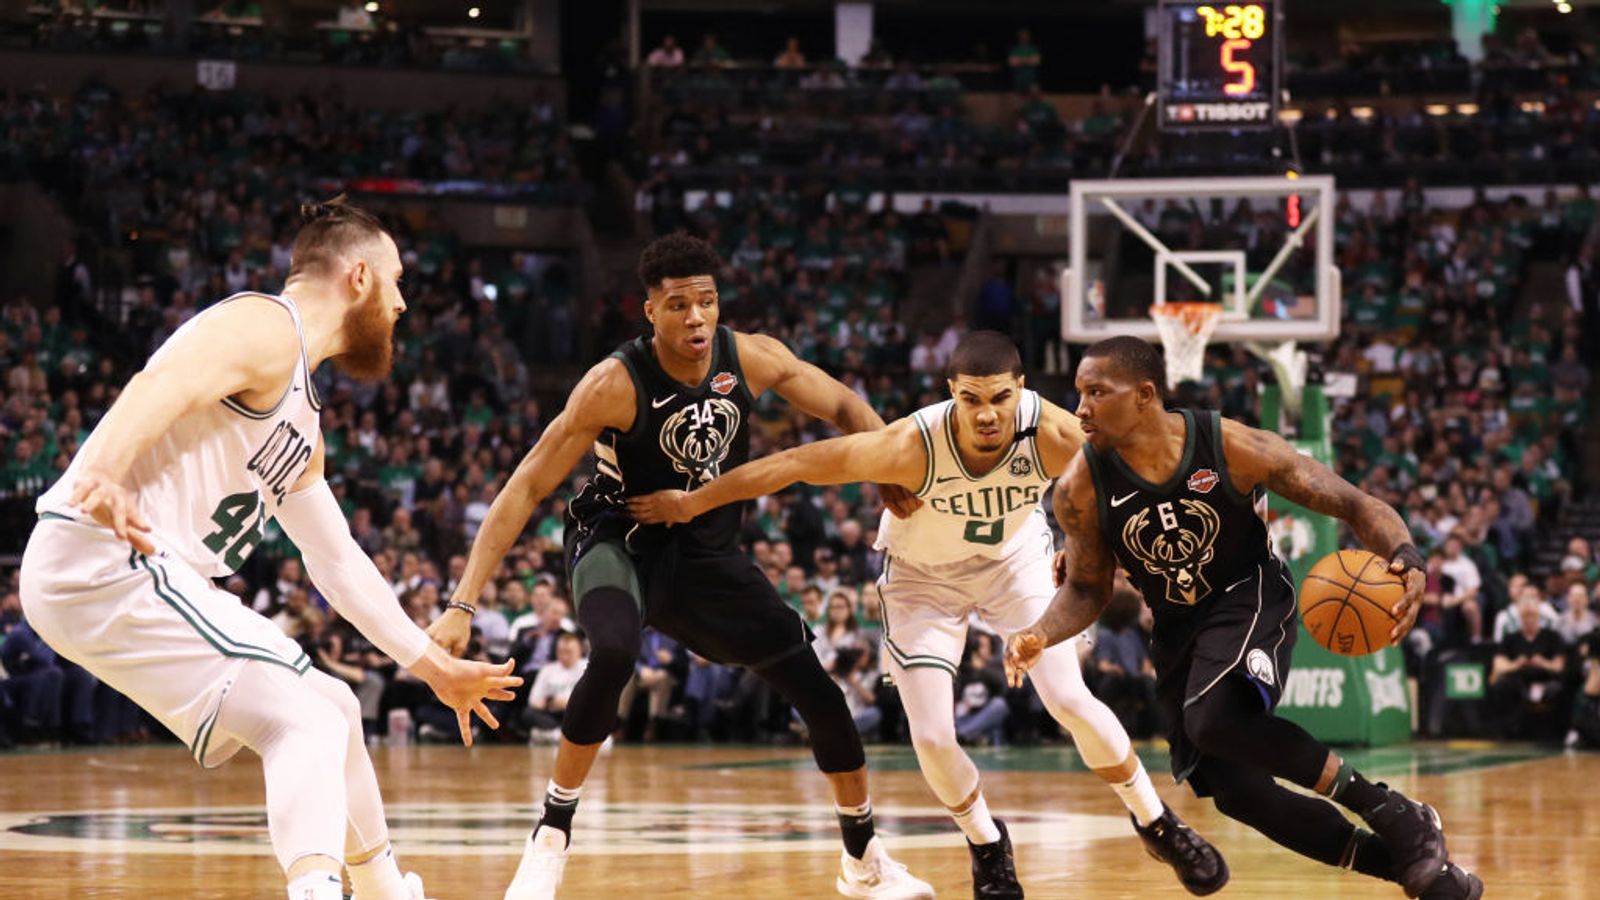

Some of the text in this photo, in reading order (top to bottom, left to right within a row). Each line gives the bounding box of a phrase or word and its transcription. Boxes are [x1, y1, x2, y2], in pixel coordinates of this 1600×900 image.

[1196, 5, 1264, 39] 7:28
[1221, 39, 1254, 96] 5
[1196, 103, 1270, 120] TISSOT
[686, 400, 715, 431] 34
[931, 485, 1040, 518] CELTICS
[1157, 501, 1179, 531] 6
[202, 489, 264, 574] 46
[963, 518, 1004, 546] 0
[1450, 669, 1482, 692] TD
